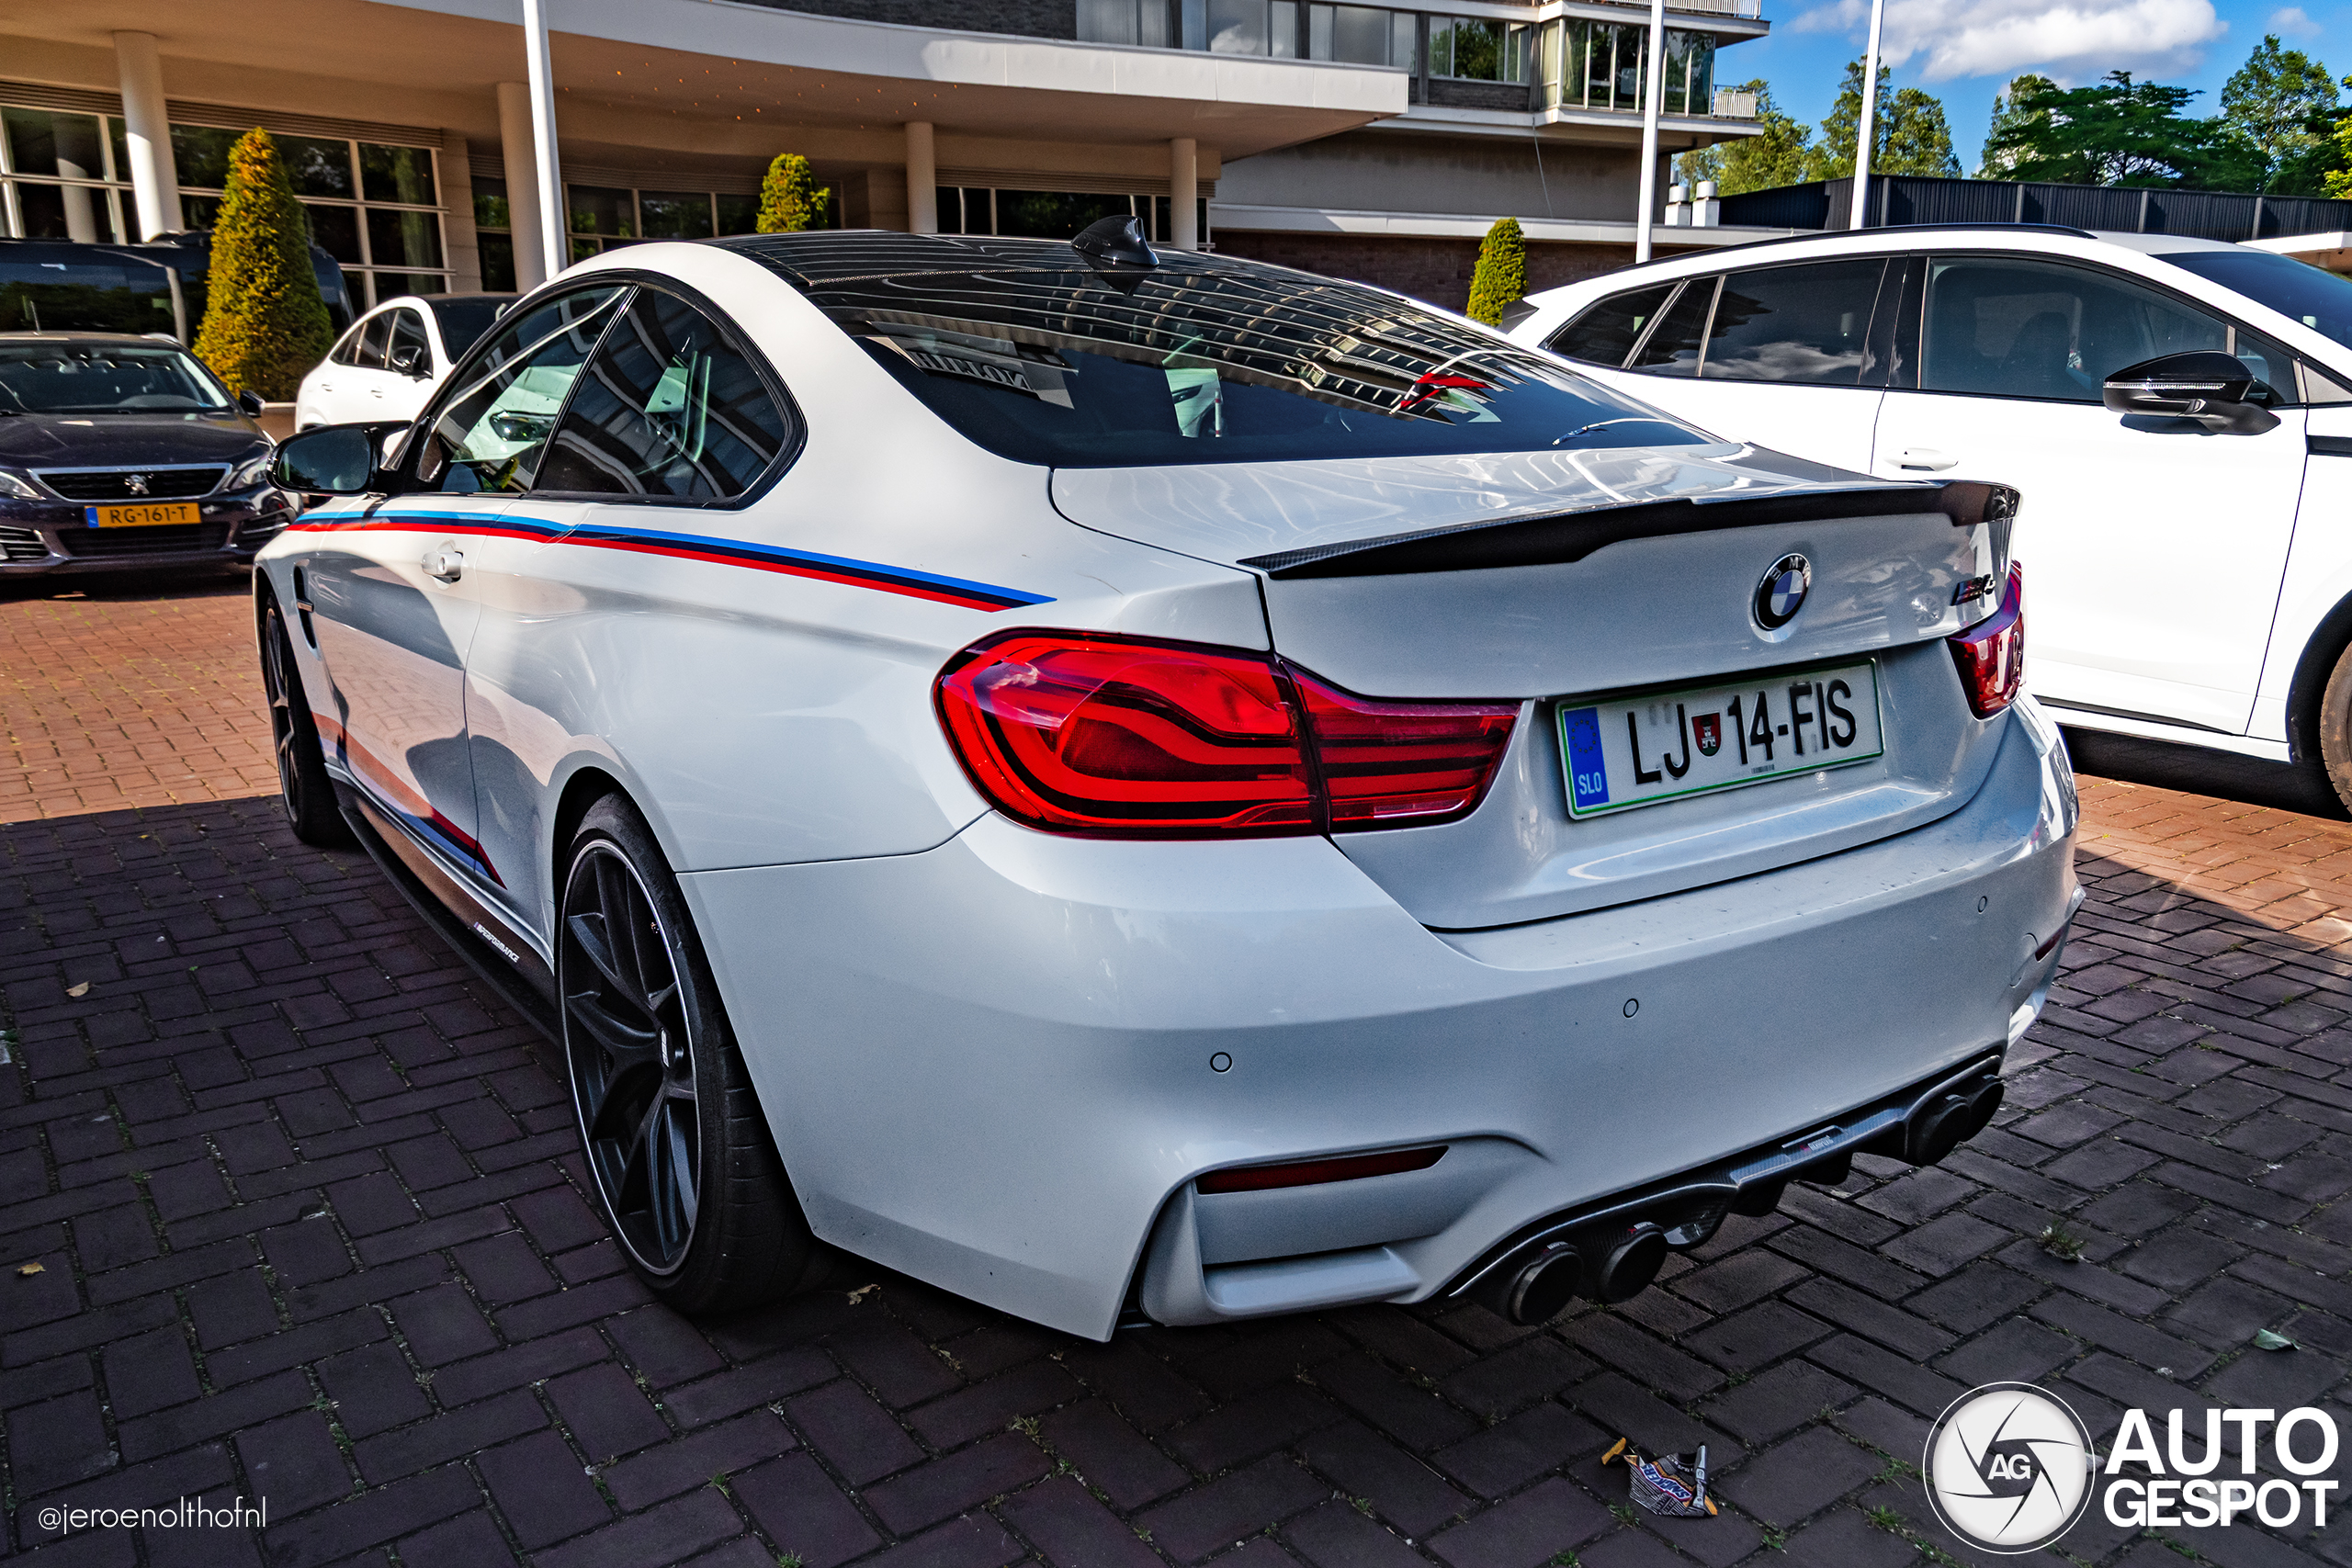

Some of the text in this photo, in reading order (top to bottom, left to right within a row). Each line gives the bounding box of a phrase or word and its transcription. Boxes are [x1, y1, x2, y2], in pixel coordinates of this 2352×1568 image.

[109, 505, 188, 525] RG-161-T
[1625, 677, 1858, 786] LJ 14-FIS
[1577, 771, 1603, 796] SLO
